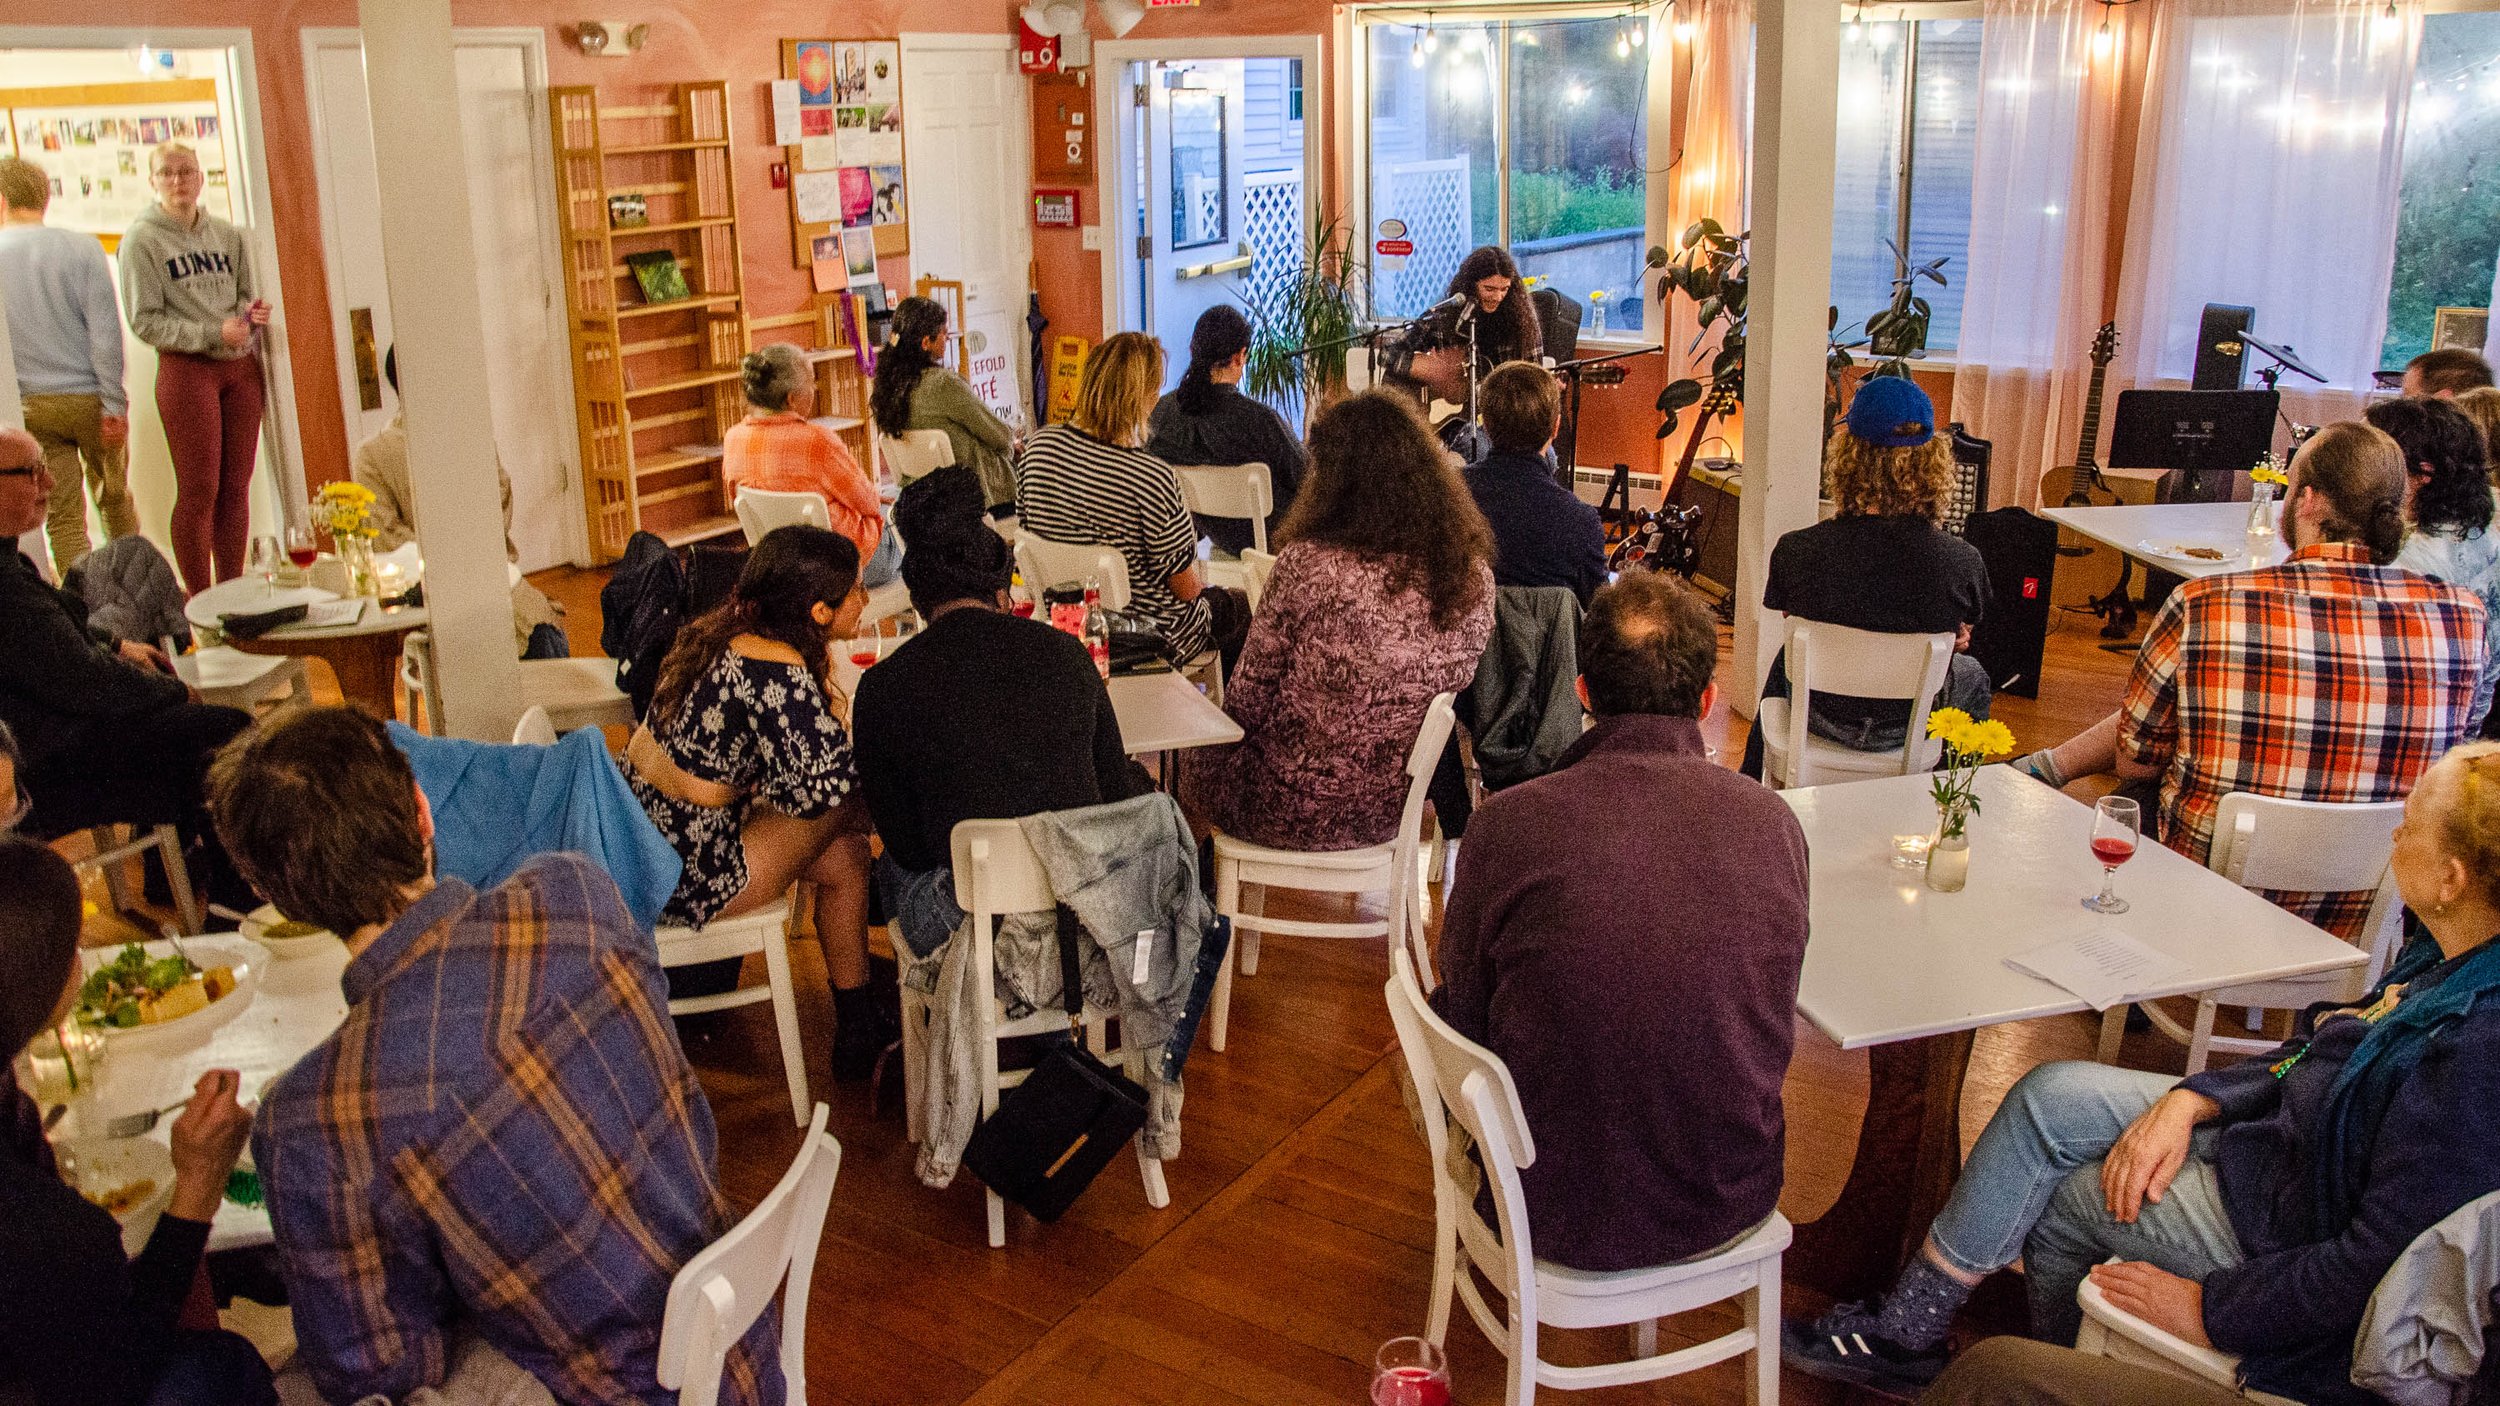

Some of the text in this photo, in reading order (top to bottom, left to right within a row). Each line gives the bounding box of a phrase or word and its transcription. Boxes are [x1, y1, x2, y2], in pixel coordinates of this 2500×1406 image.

[166, 252, 233, 279] UNH
[971, 355, 1006, 375] EFOLD
[992, 405, 1012, 419] OW
